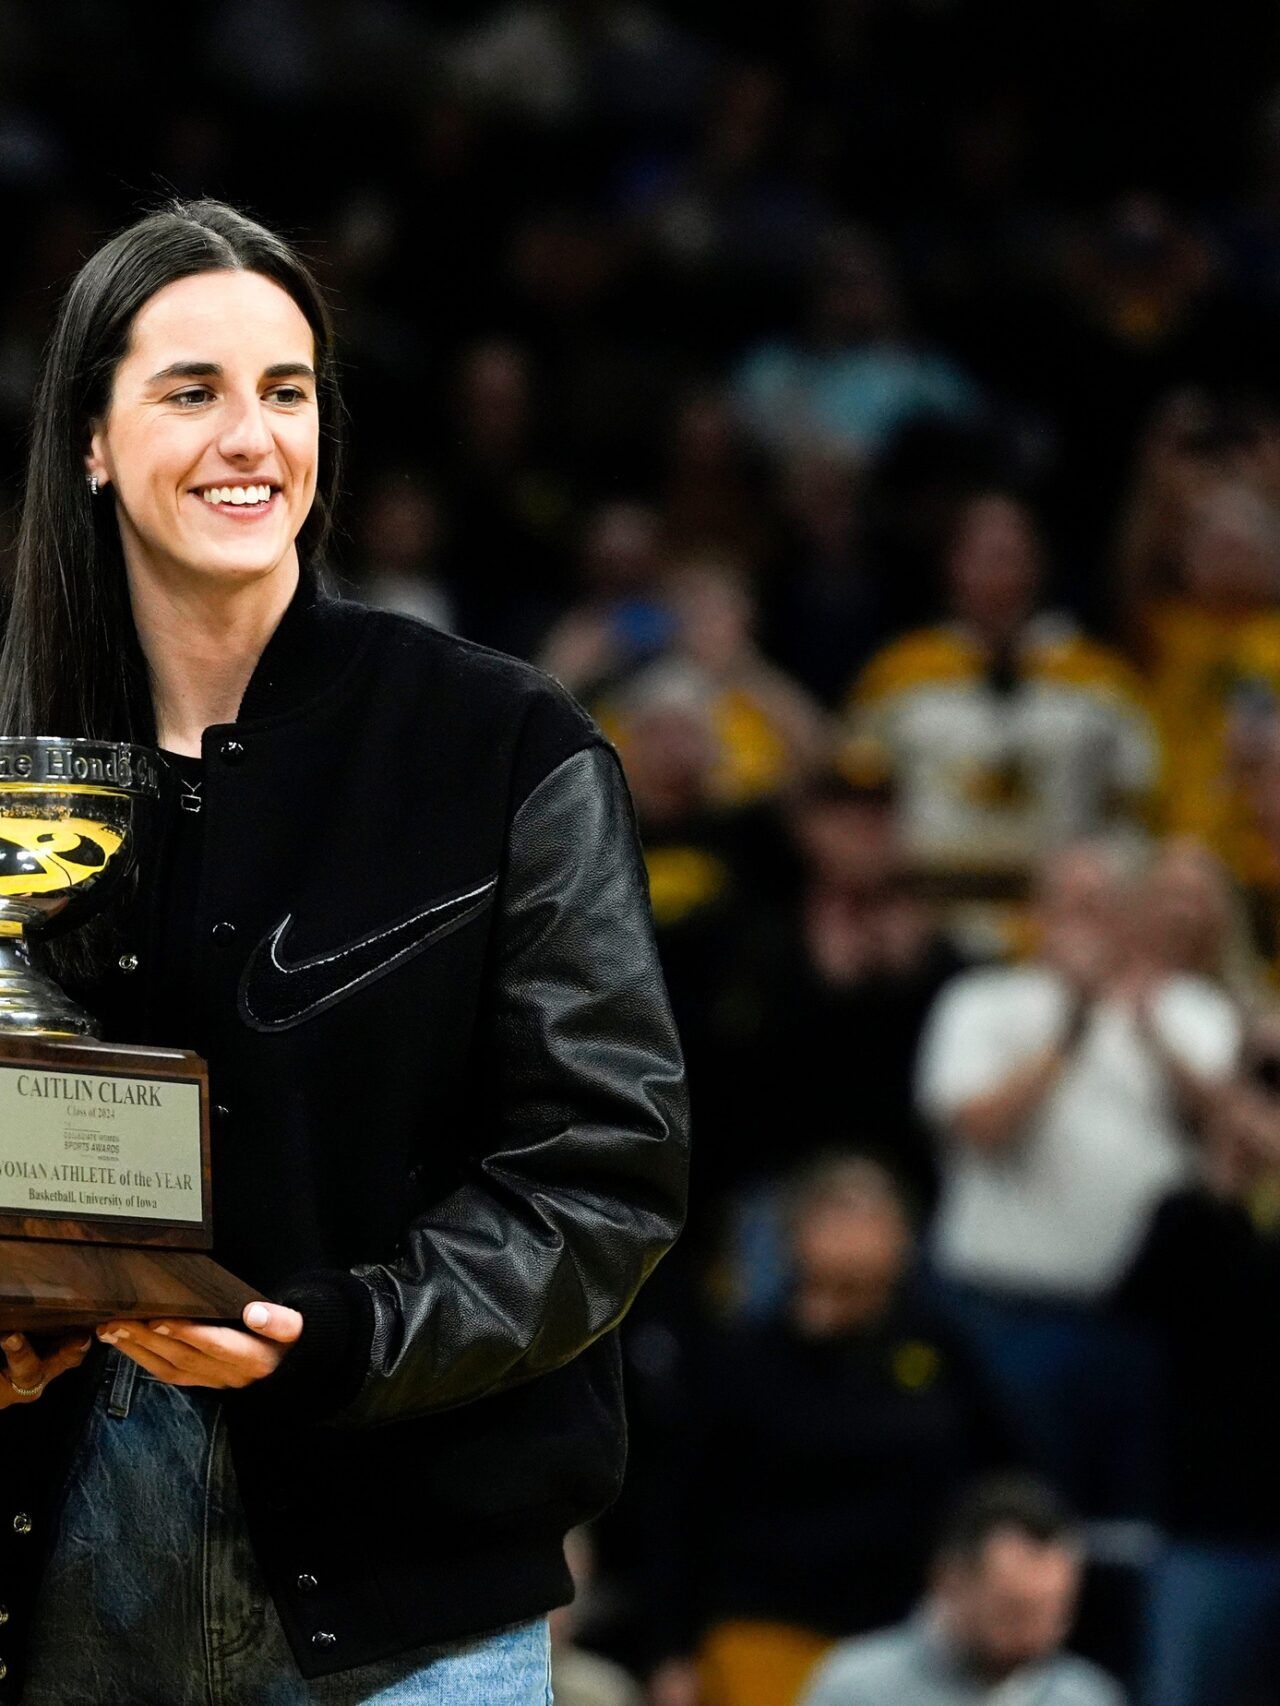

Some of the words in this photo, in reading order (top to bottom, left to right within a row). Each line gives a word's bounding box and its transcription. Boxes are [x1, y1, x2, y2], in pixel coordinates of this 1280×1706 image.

[17, 1074, 93, 1101] CAITLIN
[99, 1081, 162, 1107] CLARK
[67, 1105, 86, 1117] Class
[98, 1107, 115, 1119] 2024
[64, 1141, 90, 1152] SPORTS
[91, 1143, 120, 1154] AWARDS
[50, 1165, 116, 1185] ATHLETE
[119, 1171, 132, 1185] of
[135, 1172, 152, 1188] the
[154, 1172, 193, 1191] YEAR
[79, 1191, 122, 1210] University
[125, 1195, 135, 1208] of
[136, 1196, 157, 1209] Iowa
